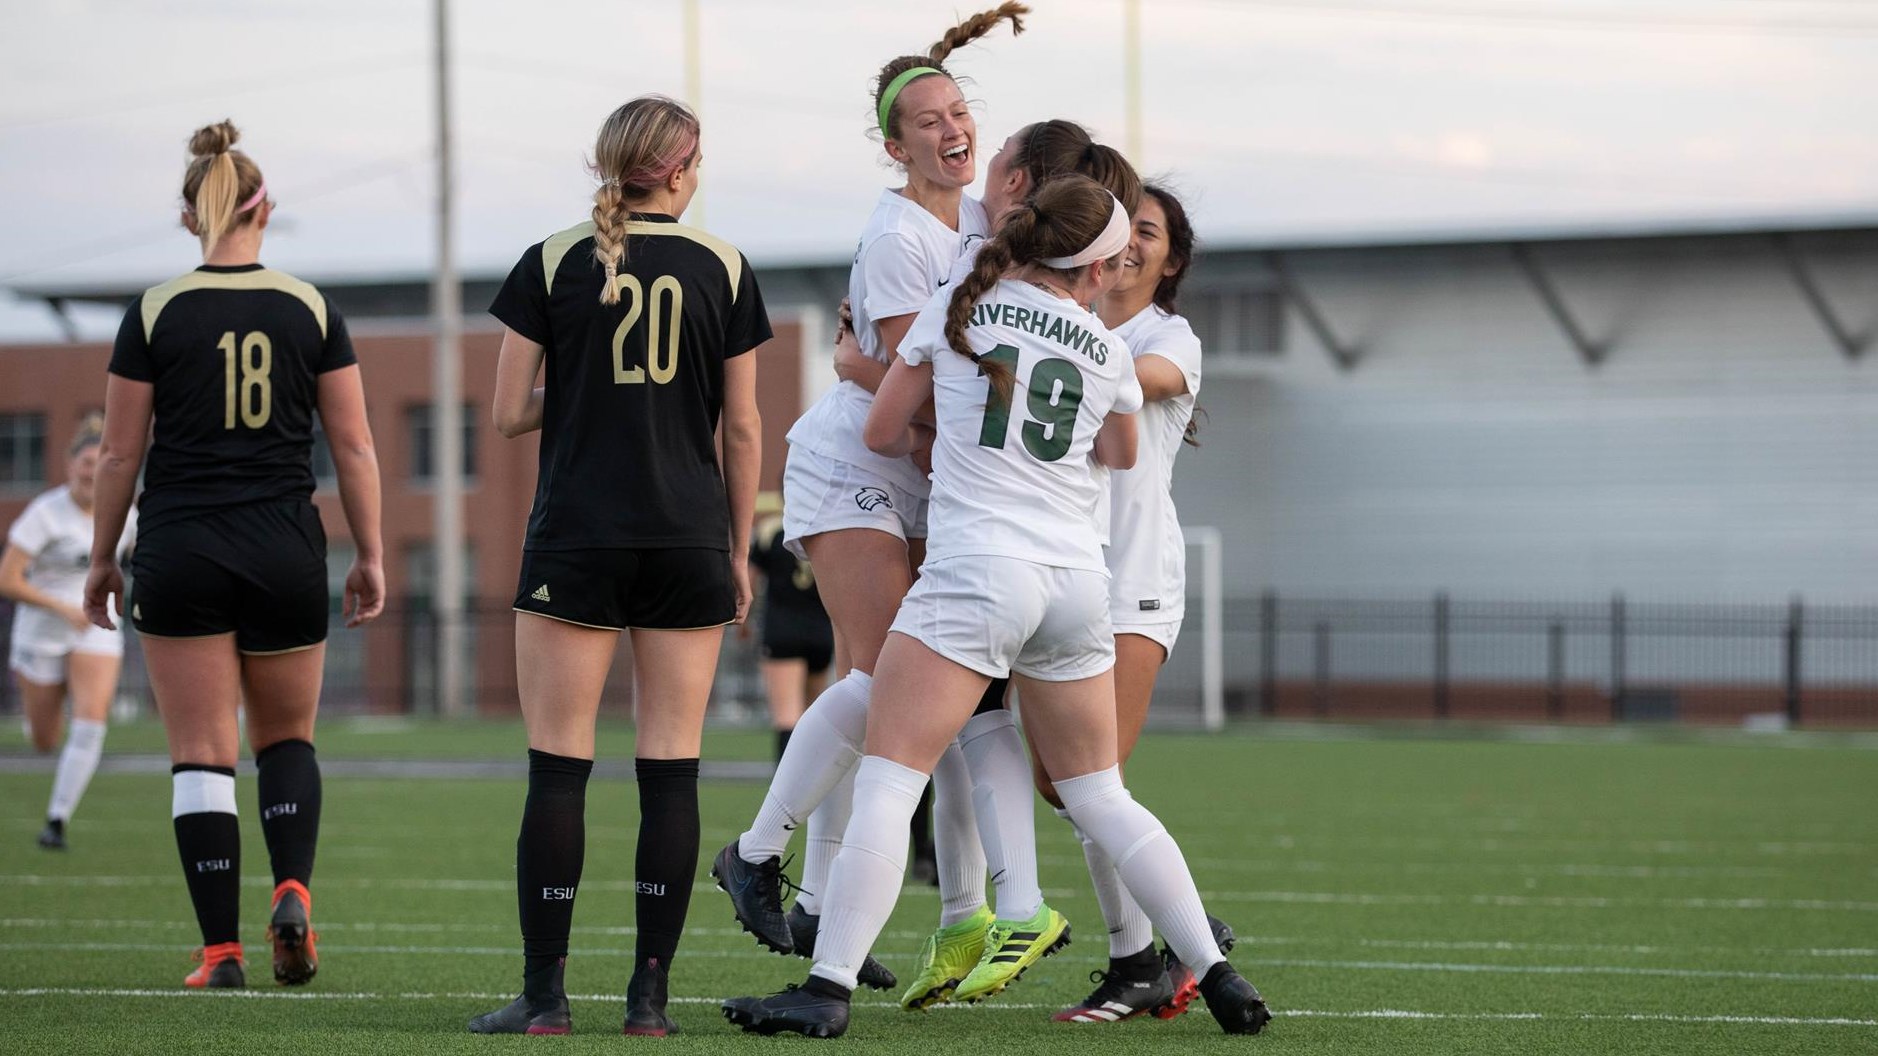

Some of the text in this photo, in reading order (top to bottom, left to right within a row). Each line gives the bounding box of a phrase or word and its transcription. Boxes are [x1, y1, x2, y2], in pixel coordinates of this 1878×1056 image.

[612, 273, 683, 385] 20
[966, 303, 1109, 367] RIVERHAWKS
[216, 330, 272, 430] 18
[977, 343, 1084, 462] 19
[264, 802, 297, 821] ESU
[196, 858, 230, 873] ESU
[542, 886, 575, 900] ESU
[636, 881, 666, 896] ESU
